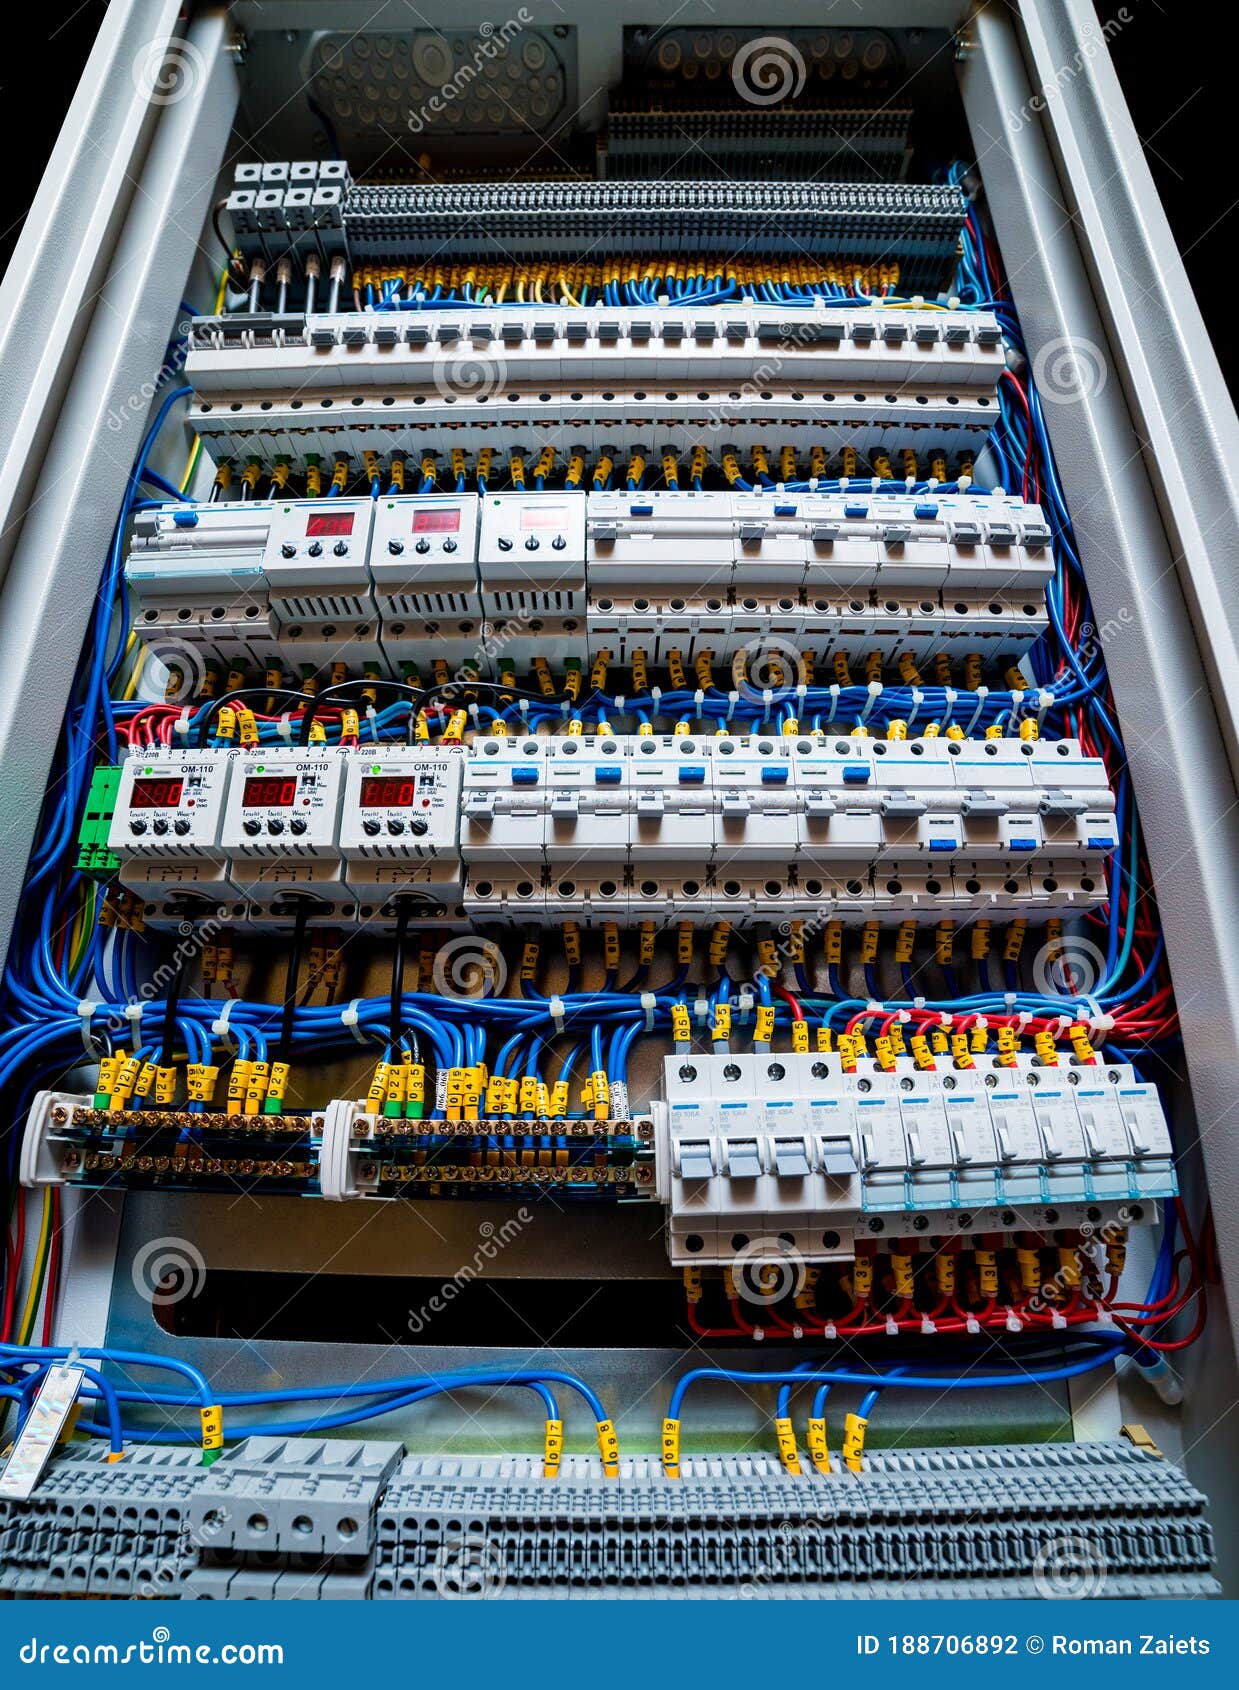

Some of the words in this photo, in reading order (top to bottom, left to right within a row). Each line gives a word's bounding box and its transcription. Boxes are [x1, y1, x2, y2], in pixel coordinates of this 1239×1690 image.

[181, 765, 214, 773] OM-110
[414, 763, 448, 771] OM-110
[676, 1006, 688, 1037] 055
[716, 1008, 729, 1038] 055
[763, 1010, 774, 1039] 055
[137, 1065, 155, 1092] 030
[157, 1072, 167, 1101] 024
[249, 1064, 264, 1098] 048
[270, 1066, 284, 1095] 023
[389, 1069, 399, 1099] 022
[409, 1068, 422, 1099] 035
[465, 1072, 477, 1102] 047
[493, 1080, 502, 1111] 045
[525, 1080, 535, 1109] 043
[556, 1084, 566, 1113] 041
[779, 1423, 796, 1460] 071
[812, 1423, 824, 1460] 072
